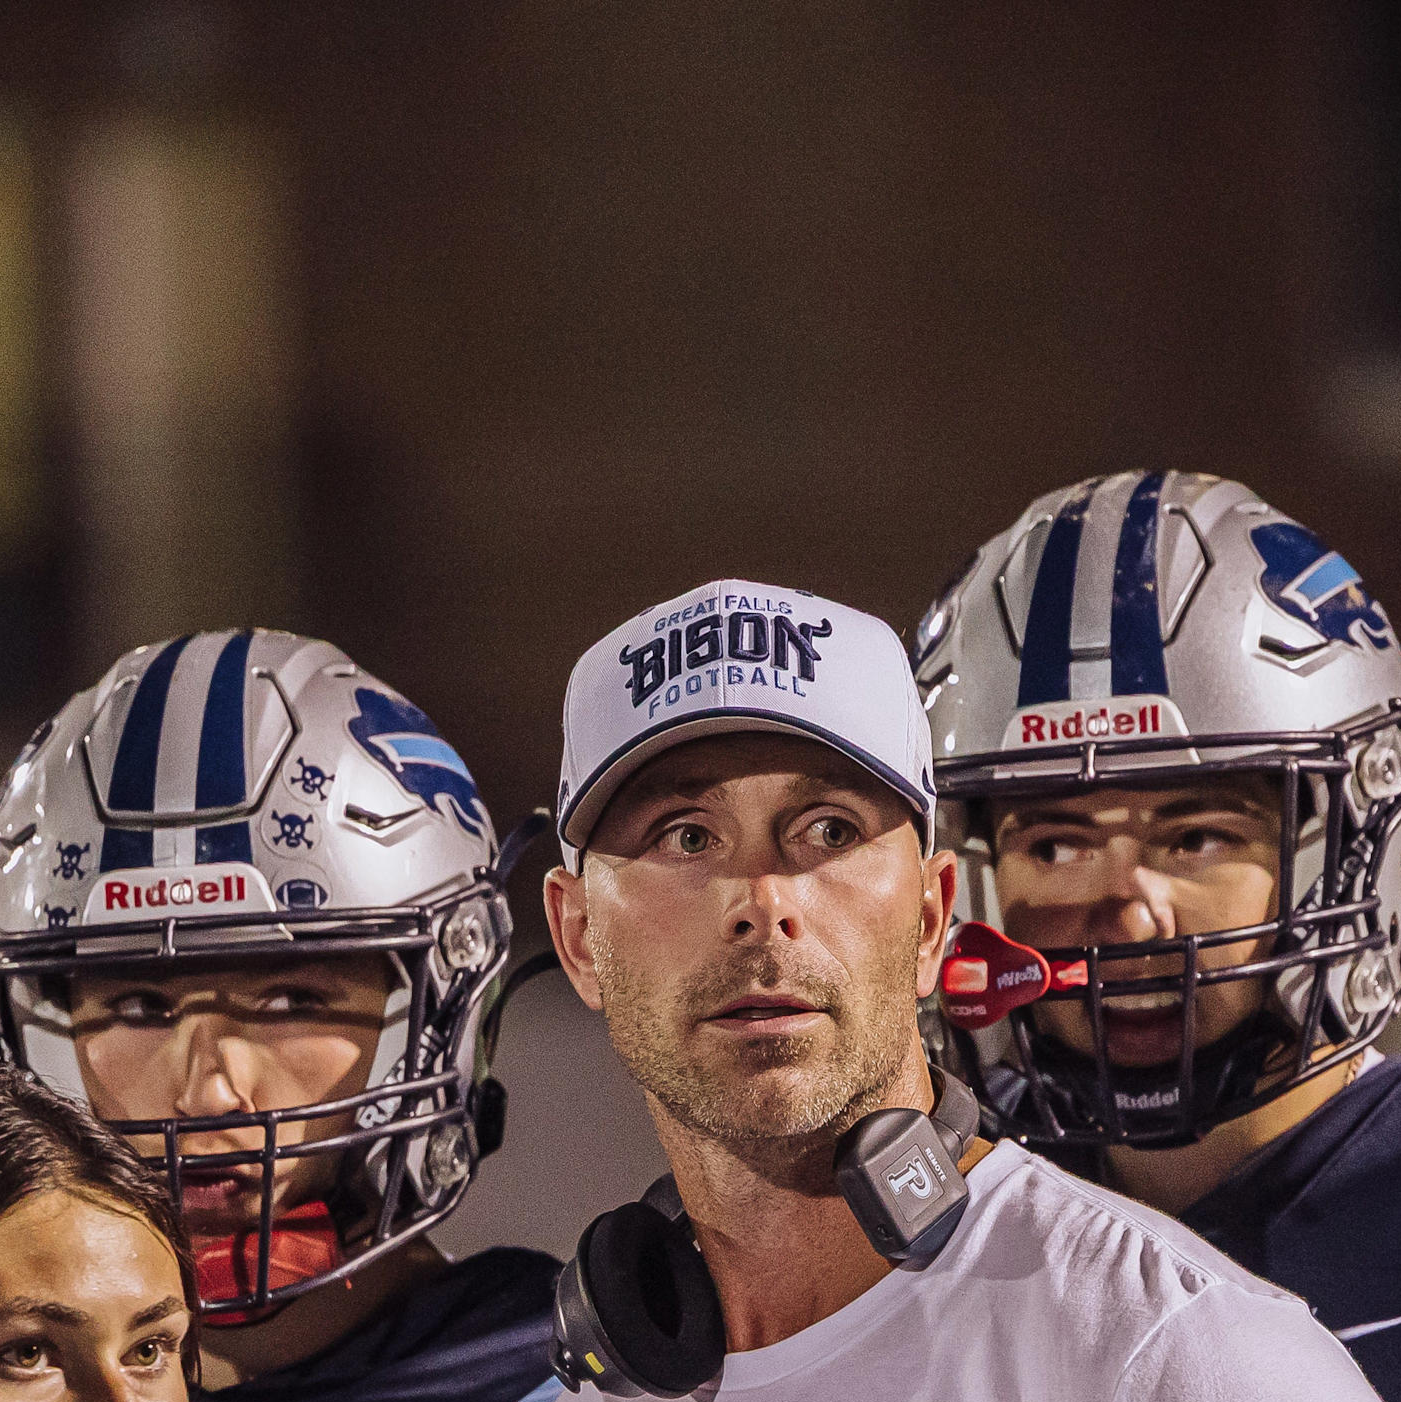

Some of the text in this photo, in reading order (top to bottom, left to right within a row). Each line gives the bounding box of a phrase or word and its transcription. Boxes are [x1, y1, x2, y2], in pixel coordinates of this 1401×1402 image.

[654, 595, 793, 633] GREAT FALLS
[619, 611, 833, 708] BISON
[648, 664, 807, 720] FOOTBALL
[1021, 704, 1160, 743] Riddell
[104, 874, 246, 910] Riddell
[1114, 1086, 1180, 1111] Riddel
